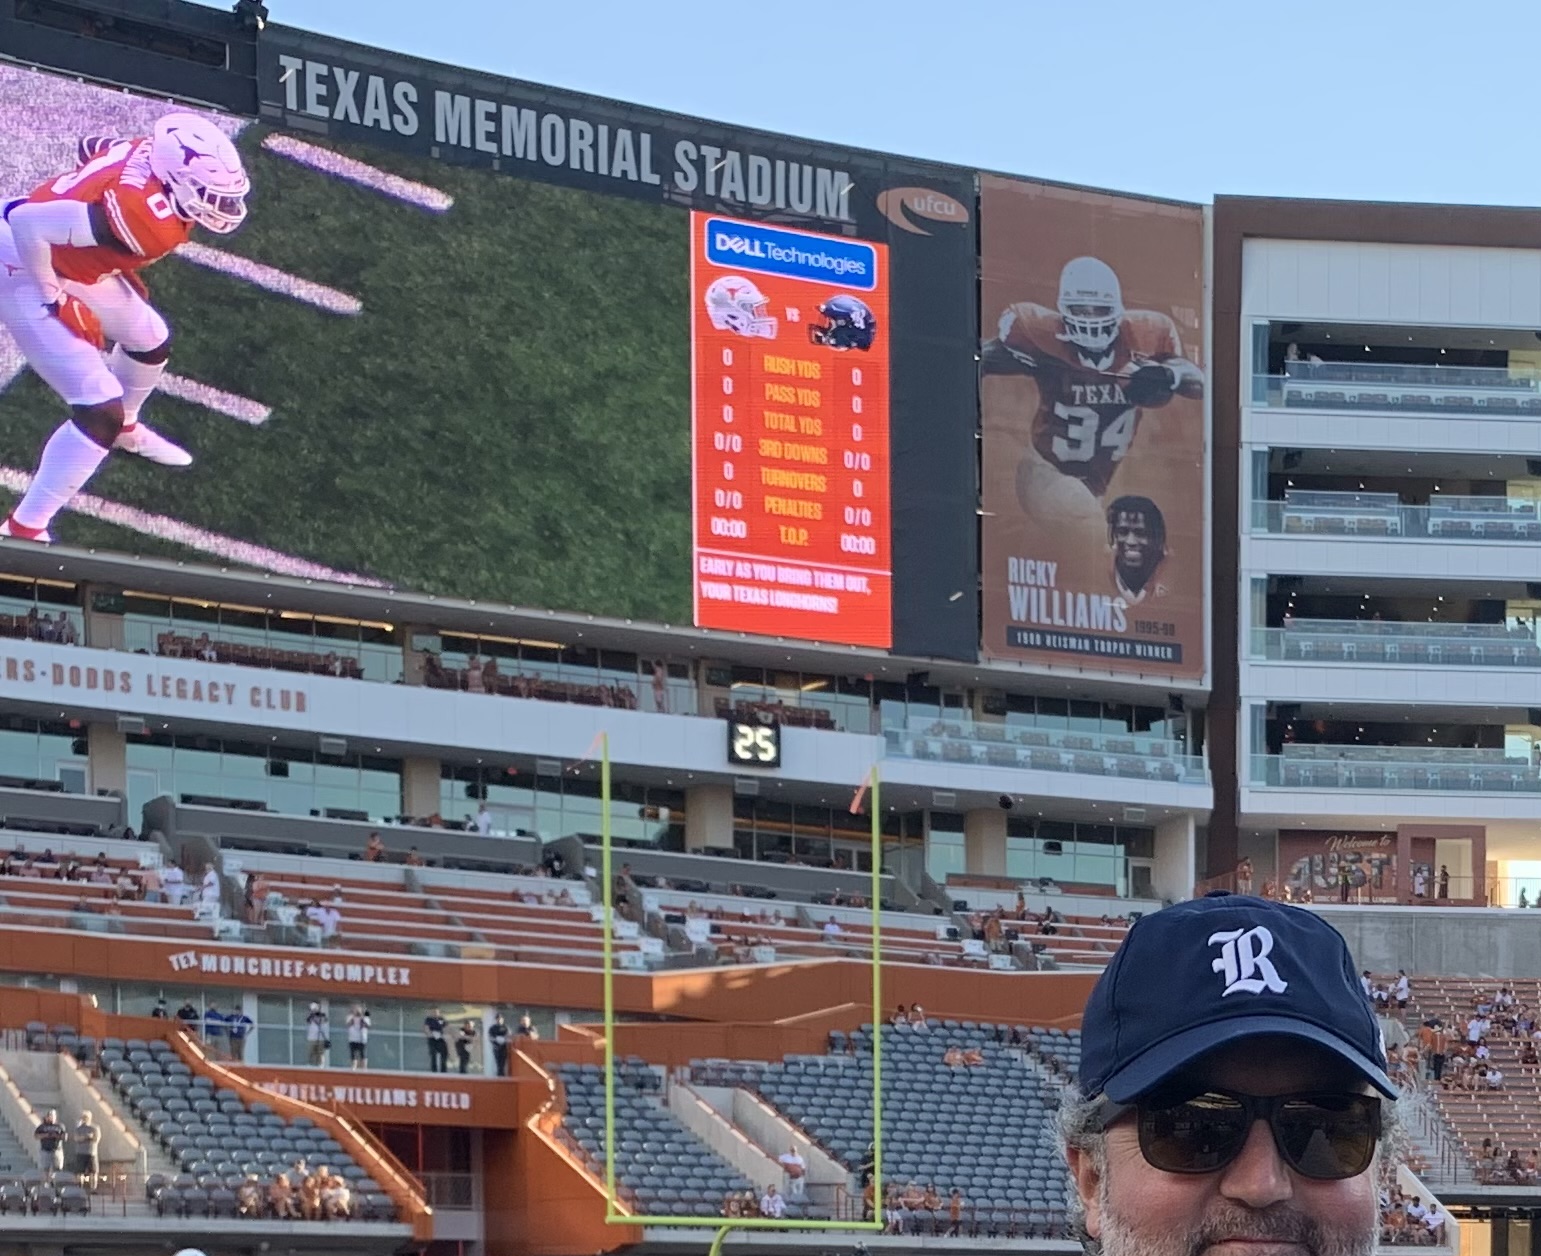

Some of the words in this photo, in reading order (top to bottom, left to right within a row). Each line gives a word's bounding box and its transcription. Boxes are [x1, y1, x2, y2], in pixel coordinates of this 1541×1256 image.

[279, 54, 418, 135] TEXAS
[435, 91, 662, 185] MEMORIAL
[674, 140, 851, 220] STADIUM
[914, 195, 955, 215] ufcu
[716, 233, 765, 258] DELL
[765, 242, 867, 275] Technologies
[722, 347, 733, 367] 0
[764, 355, 795, 375] RUSH
[795, 360, 822, 380] YDS
[851, 367, 862, 386] 0
[722, 376, 733, 396] 0
[764, 383, 796, 404] PASS
[797, 387, 821, 408] YDS
[851, 395, 863, 414] 0
[1071, 384, 1133, 405] TEXA
[722, 405, 734, 423] 0
[763, 411, 797, 433] TOTAL
[799, 417, 822, 436] YDS
[852, 423, 863, 442] 0
[1051, 400, 1140, 463] 34
[714, 432, 743, 453] 0/0
[784, 442, 828, 465] DOWNS
[843, 450, 871, 471] 0/0
[723, 461, 734, 480] 0
[760, 467, 827, 493] TURNOVERS
[852, 479, 863, 497] 0
[714, 488, 743, 509] 0/0
[764, 495, 822, 520] PENALTIES
[844, 506, 872, 527] 0/0
[711, 517, 747, 539] 00:00
[840, 534, 876, 555] 00:00
[1008, 556, 1058, 587] RICKY
[1008, 584, 1128, 633] WILLIAMS
[147, 674, 236, 706] LEGACY
[250, 687, 307, 713] CLUB
[733, 724, 776, 762] 25
[1325, 835, 1376, 851] Welcome
[1380, 834, 1392, 848] to
[168, 951, 199, 971] TEX
[201, 953, 304, 978] MONCRIEF
[319, 962, 411, 986] COMPLEX
[424, 1090, 471, 1110] FIELD
